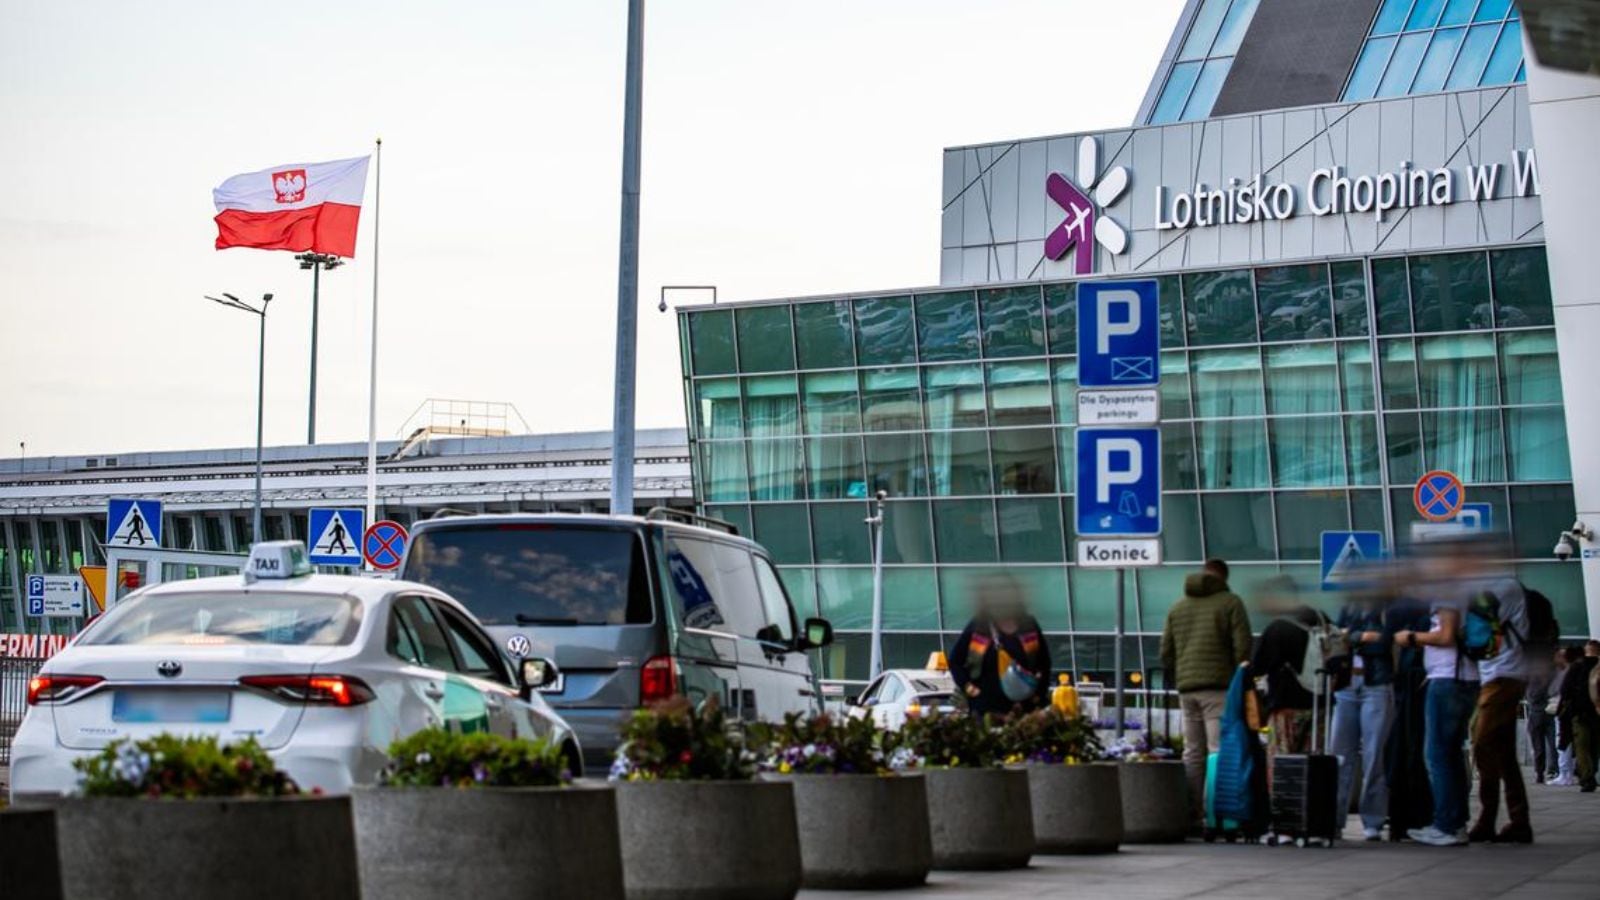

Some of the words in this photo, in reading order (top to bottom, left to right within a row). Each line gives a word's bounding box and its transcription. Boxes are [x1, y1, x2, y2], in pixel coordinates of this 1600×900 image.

[1155, 173, 1296, 230] Lotnisko
[1307, 161, 1454, 222] Chopina
[1467, 163, 1502, 201] w
[1096, 289, 1141, 354] P
[1096, 438, 1142, 503] P
[1087, 545, 1150, 561] Koniec
[255, 558, 279, 570] TAXI
[32, 582, 42, 594] P
[32, 600, 42, 612] P
[0, 633, 69, 659] ERMIN
